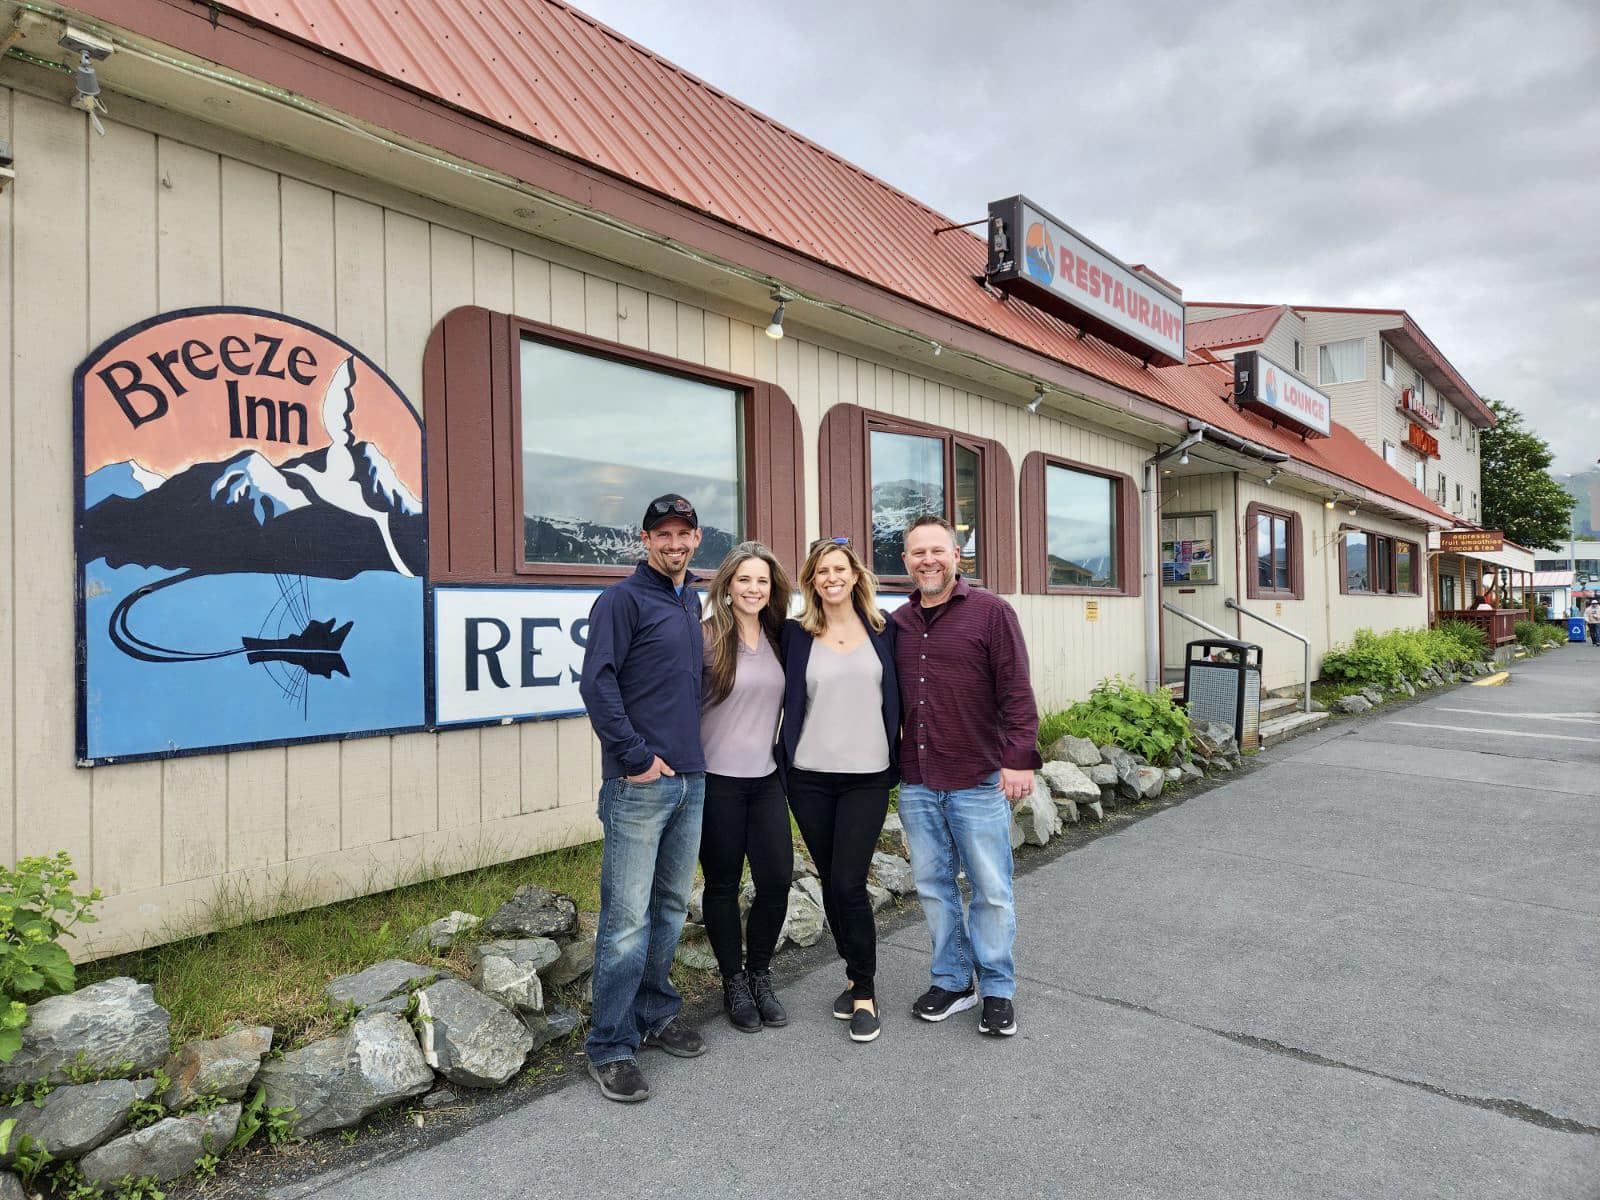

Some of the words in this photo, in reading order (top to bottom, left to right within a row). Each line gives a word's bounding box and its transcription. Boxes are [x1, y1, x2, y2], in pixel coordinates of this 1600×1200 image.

[1060, 245, 1181, 344] RESTAURANT
[96, 333, 317, 429] Breeze
[225, 380, 308, 445] Inn
[1283, 383, 1325, 421] LOUNGE
